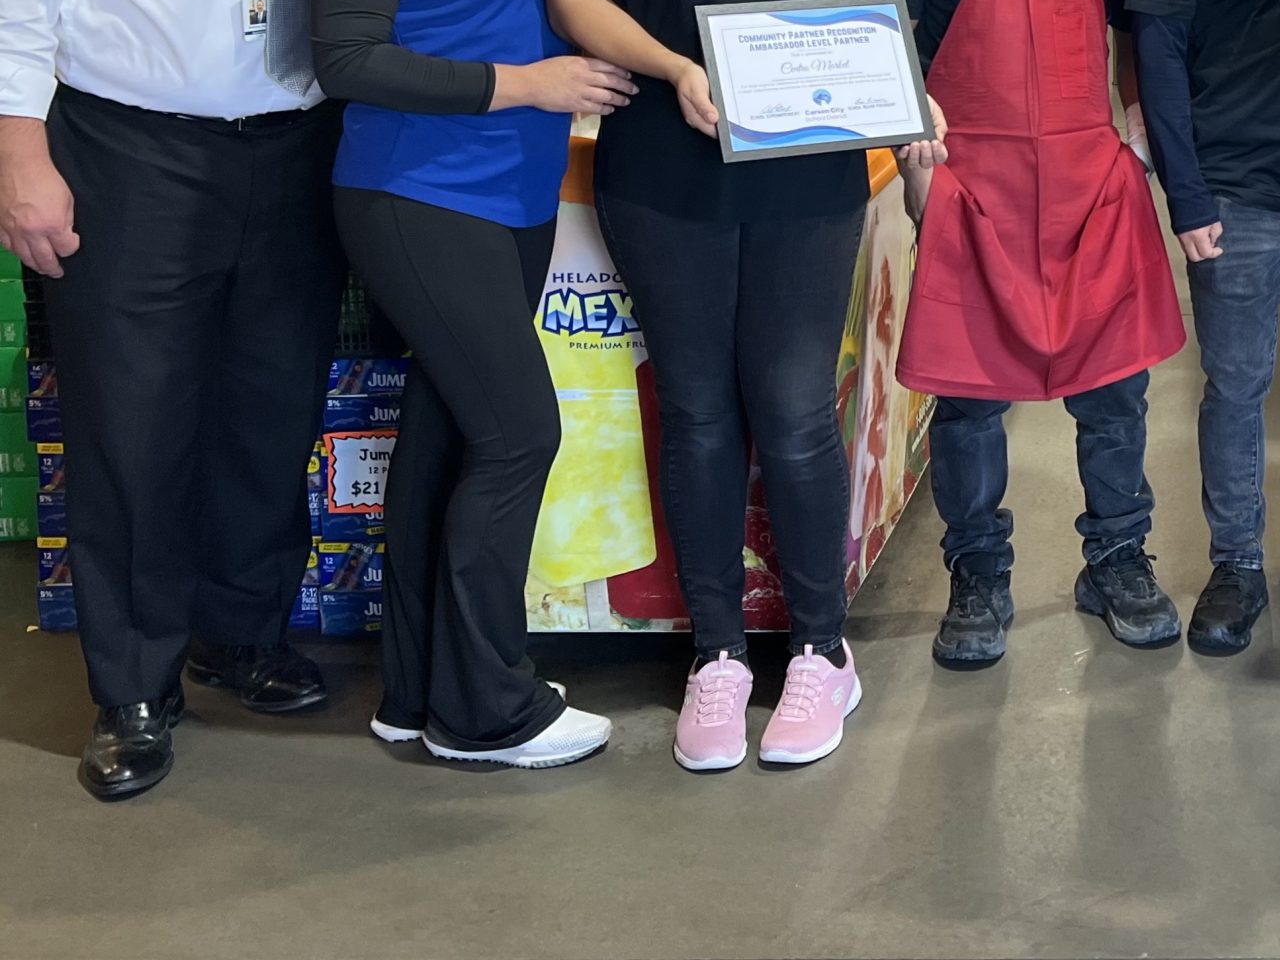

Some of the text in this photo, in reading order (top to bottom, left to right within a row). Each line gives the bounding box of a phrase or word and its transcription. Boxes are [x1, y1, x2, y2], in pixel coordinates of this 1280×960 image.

[738, 26, 877, 44] COMMUNITY PARTNER RECOGNITION
[749, 36, 870, 52] AMBASSADOR LEVEL PARTNER
[804, 108, 830, 116] Carson
[830, 106, 845, 114] City
[552, 272, 623, 284] HELADO
[569, 341, 623, 350] PREMIUM
[42, 458, 52, 466] 12
[368, 466, 379, 475] 12
[351, 480, 380, 497] $21
[43, 552, 53, 560] 12
[324, 557, 334, 565] 12
